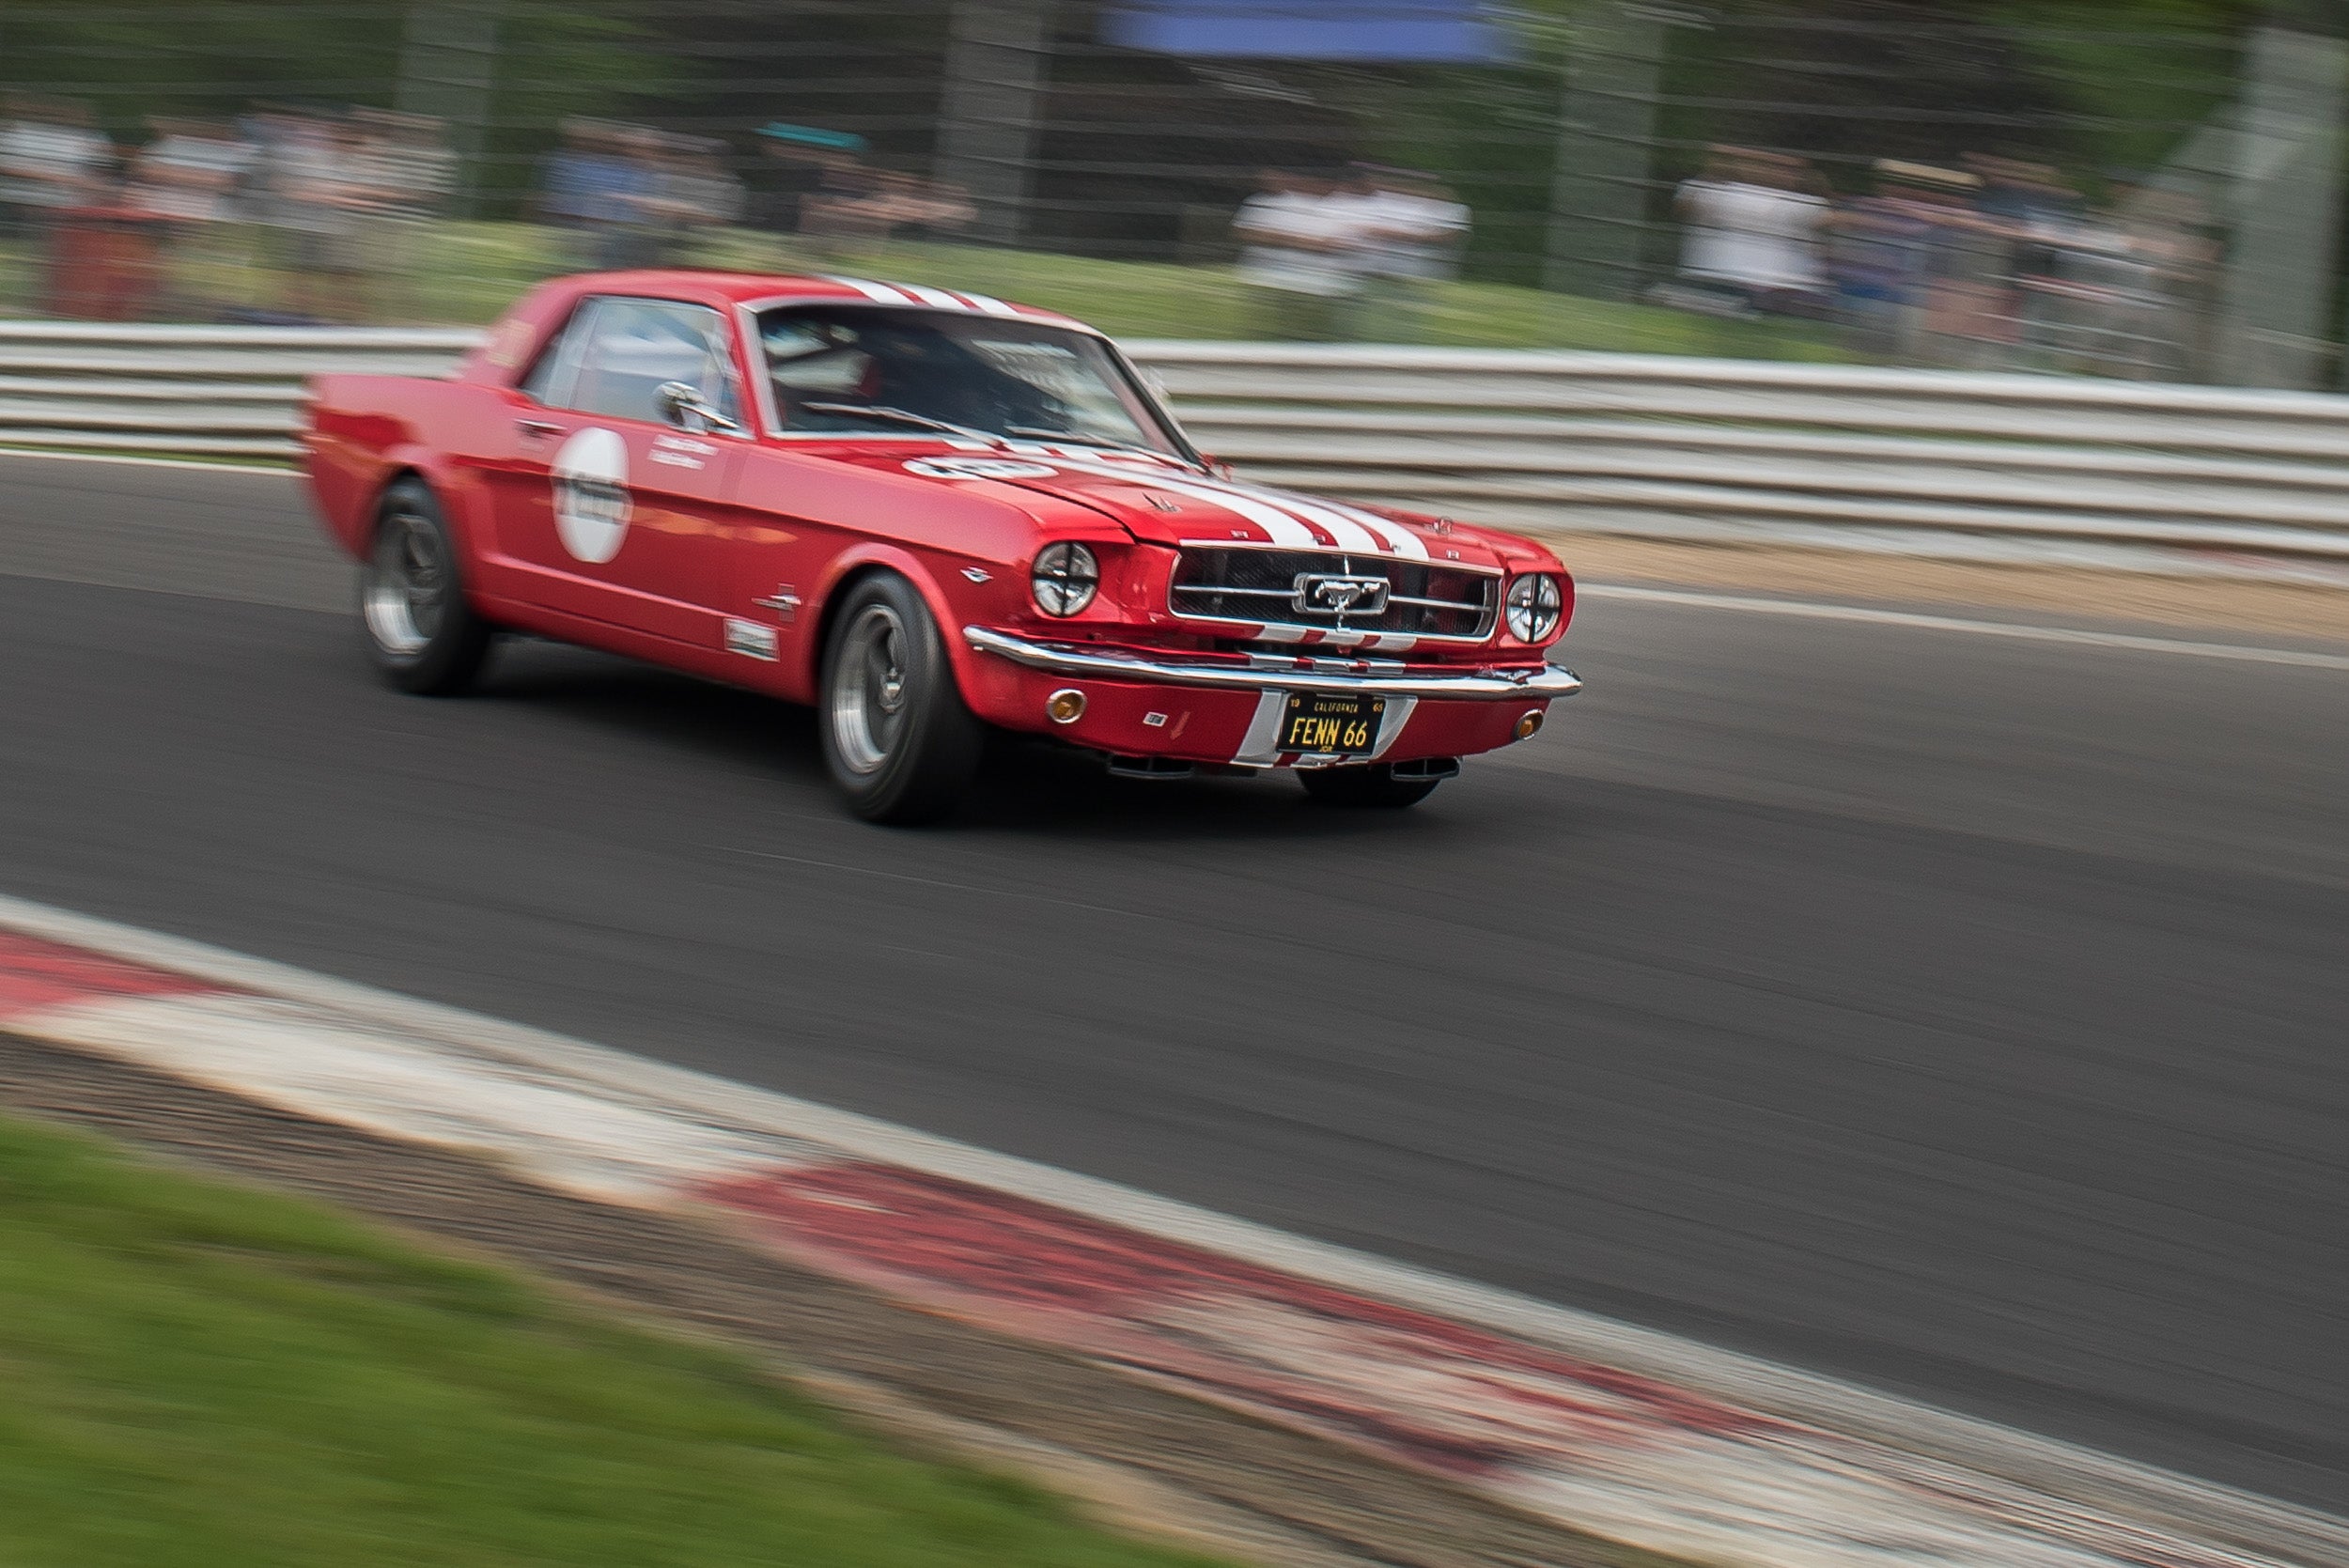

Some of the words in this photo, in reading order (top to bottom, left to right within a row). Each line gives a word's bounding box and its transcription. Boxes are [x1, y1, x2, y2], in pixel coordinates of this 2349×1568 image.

[1315, 702, 1359, 713] CALIFORNIA
[1289, 718, 1341, 745] FENN
[1344, 720, 1367, 747] 66
